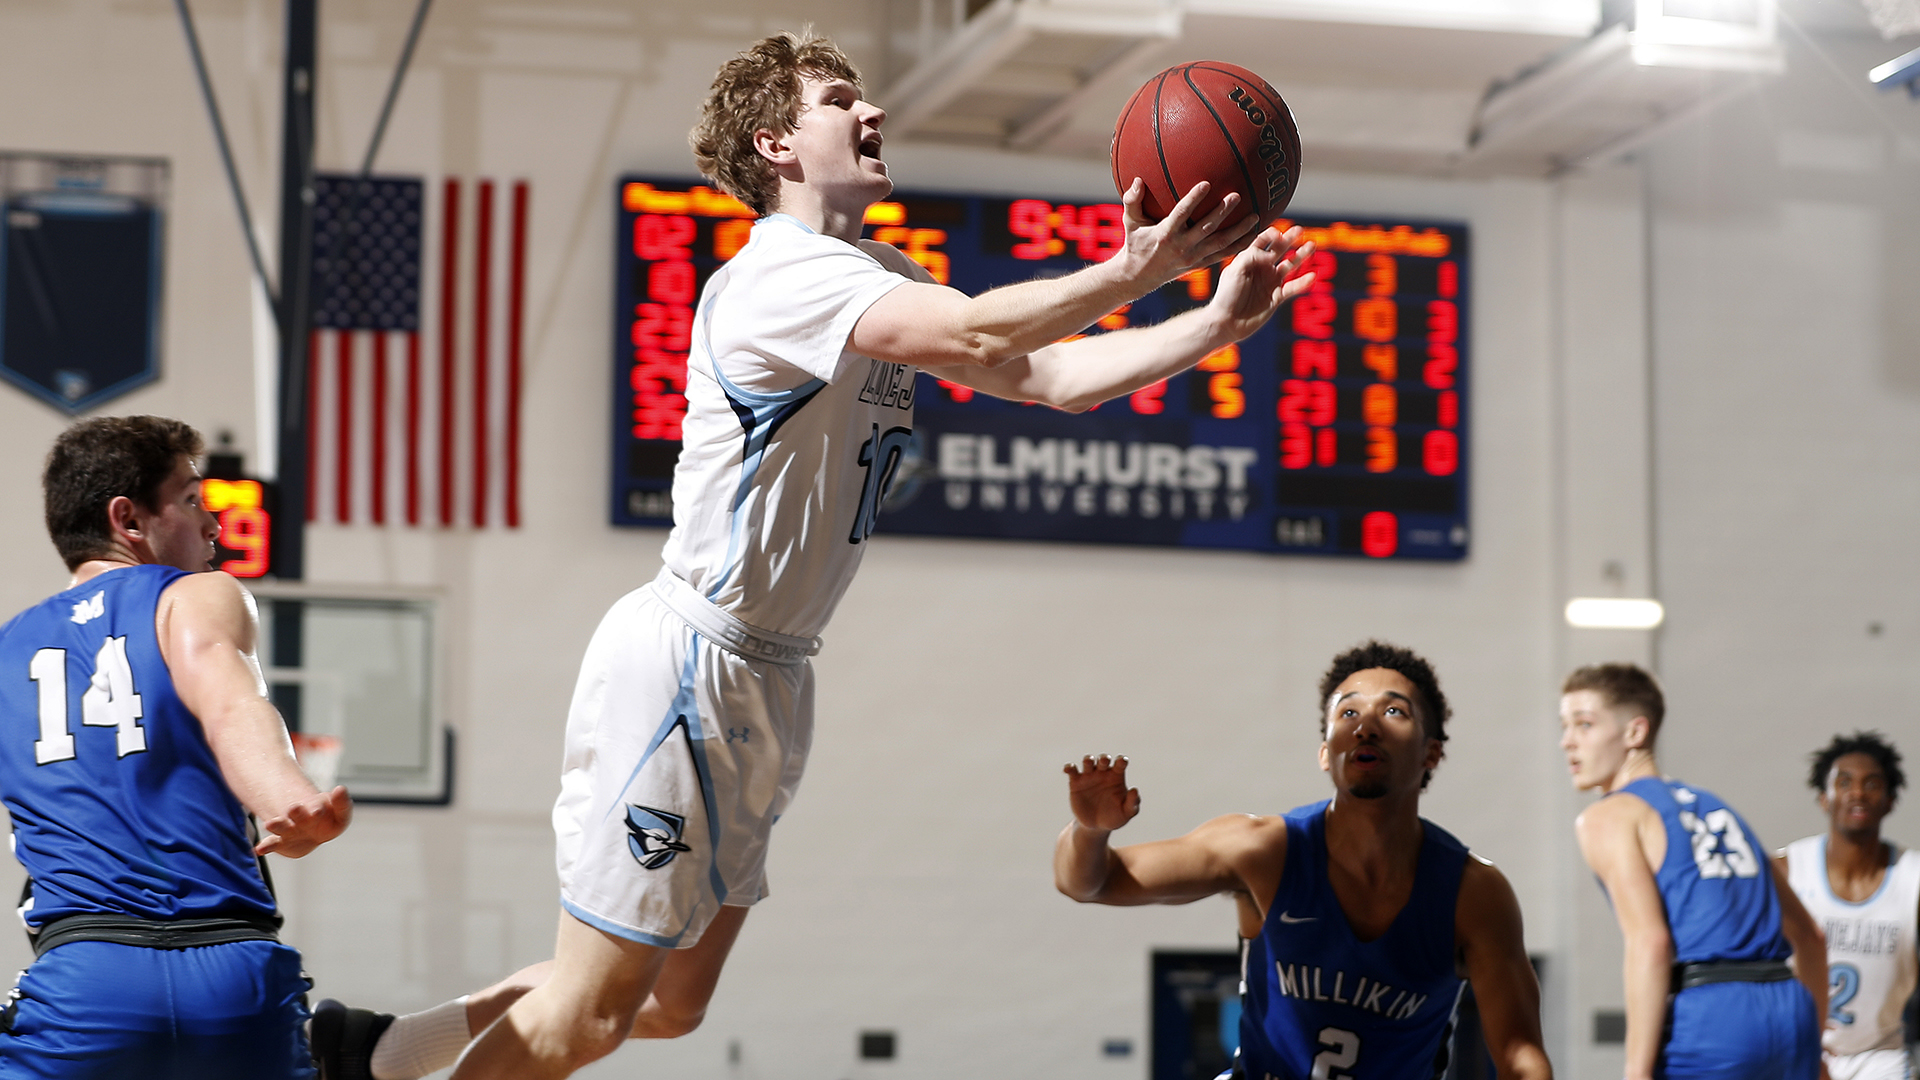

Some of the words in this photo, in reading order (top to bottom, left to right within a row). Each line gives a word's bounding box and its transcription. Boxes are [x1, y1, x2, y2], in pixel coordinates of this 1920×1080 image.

[1228, 86, 1290, 211] Wilson
[1008, 199, 1125, 263] 9:43
[937, 433, 1258, 491] ELMHURST
[944, 482, 1251, 522] UNIVERSITY
[29, 634, 148, 766] 14
[1679, 810, 1759, 880] 23
[1276, 961, 1427, 1020] MILLIKIN
[1828, 963, 1860, 1025] 2
[1310, 1026, 1361, 1080] 2
